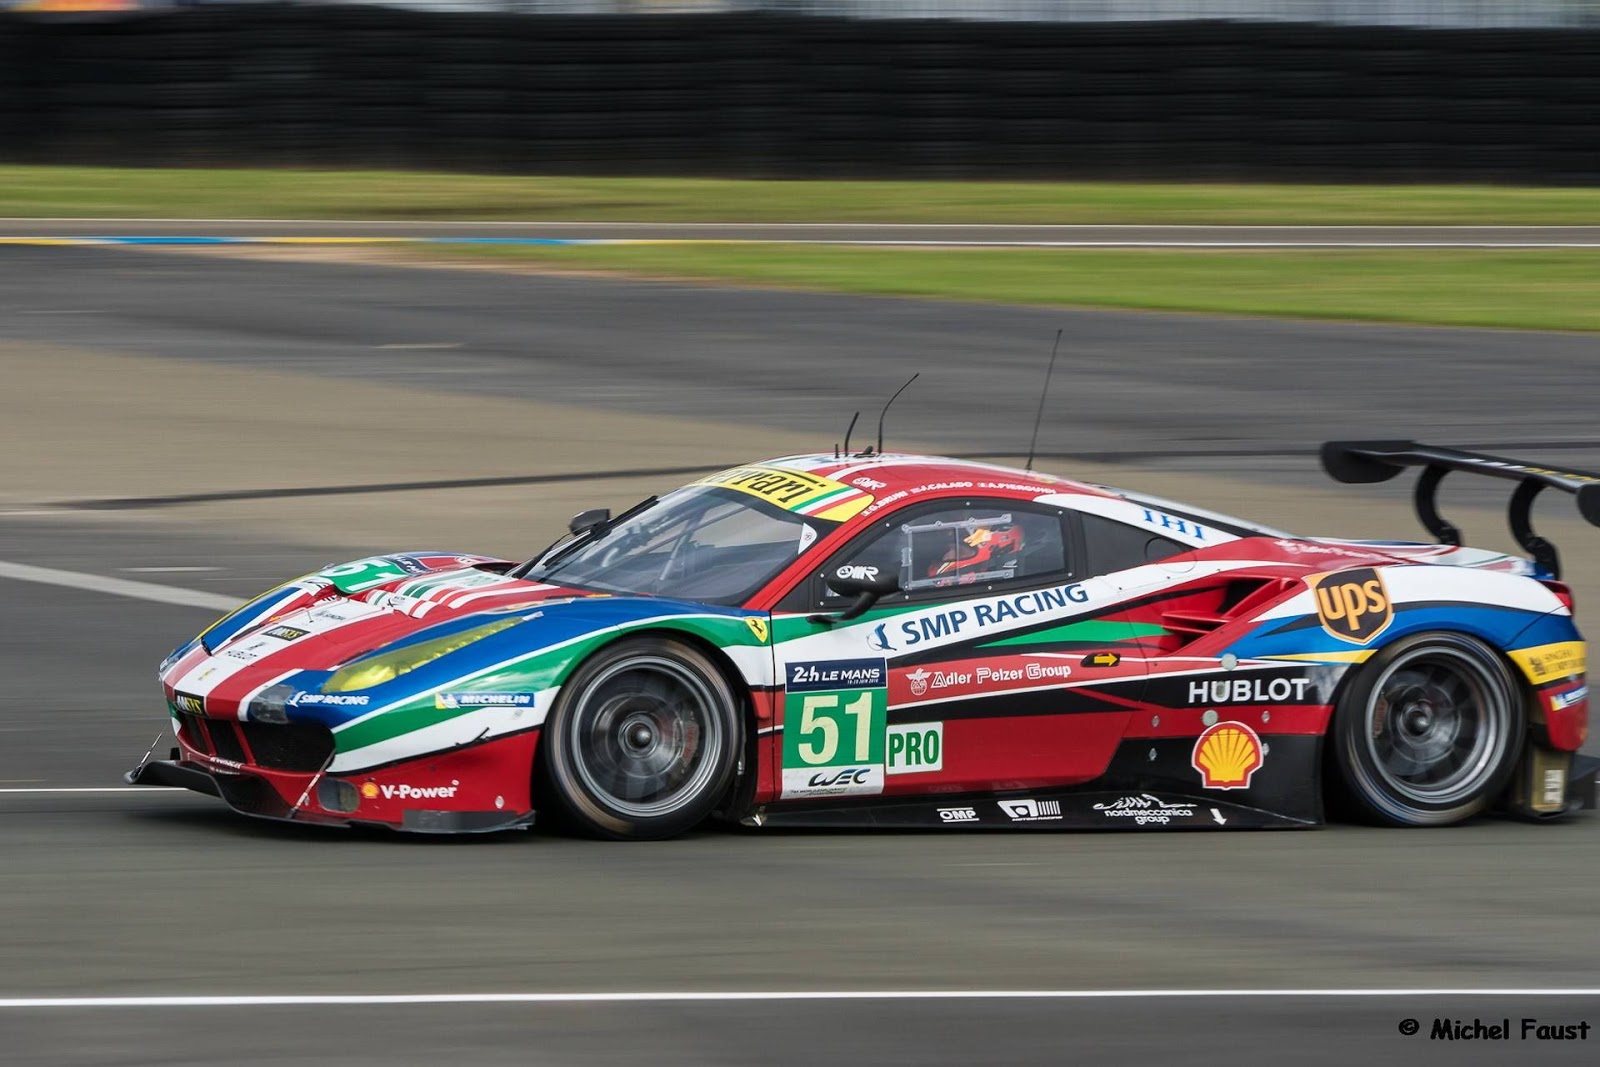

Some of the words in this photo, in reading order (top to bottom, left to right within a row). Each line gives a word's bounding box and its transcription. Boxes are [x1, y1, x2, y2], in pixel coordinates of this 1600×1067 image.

[703, 464, 827, 503] errari
[1143, 510, 1205, 540] IHI
[321, 559, 409, 592] 51
[901, 610, 967, 645] SMP
[974, 584, 1089, 627] RACING
[1318, 580, 1387, 631] ups
[793, 666, 819, 683] 24h
[822, 671, 839, 681] LE
[841, 668, 880, 679] MANS
[930, 671, 972, 689] Adler
[976, 667, 1023, 684] Pelzer
[1026, 663, 1072, 680] Group
[321, 694, 370, 705] RACING
[460, 695, 531, 704] MICHELIN
[1188, 678, 1310, 703] HUBLOT
[798, 692, 873, 765] 51
[888, 730, 940, 767] PRO
[808, 768, 871, 787] WEC
[380, 784, 457, 799] V-Power
[940, 810, 976, 820] OMP
[1104, 808, 1193, 817] nordmeccanica
[1135, 816, 1170, 825] group
